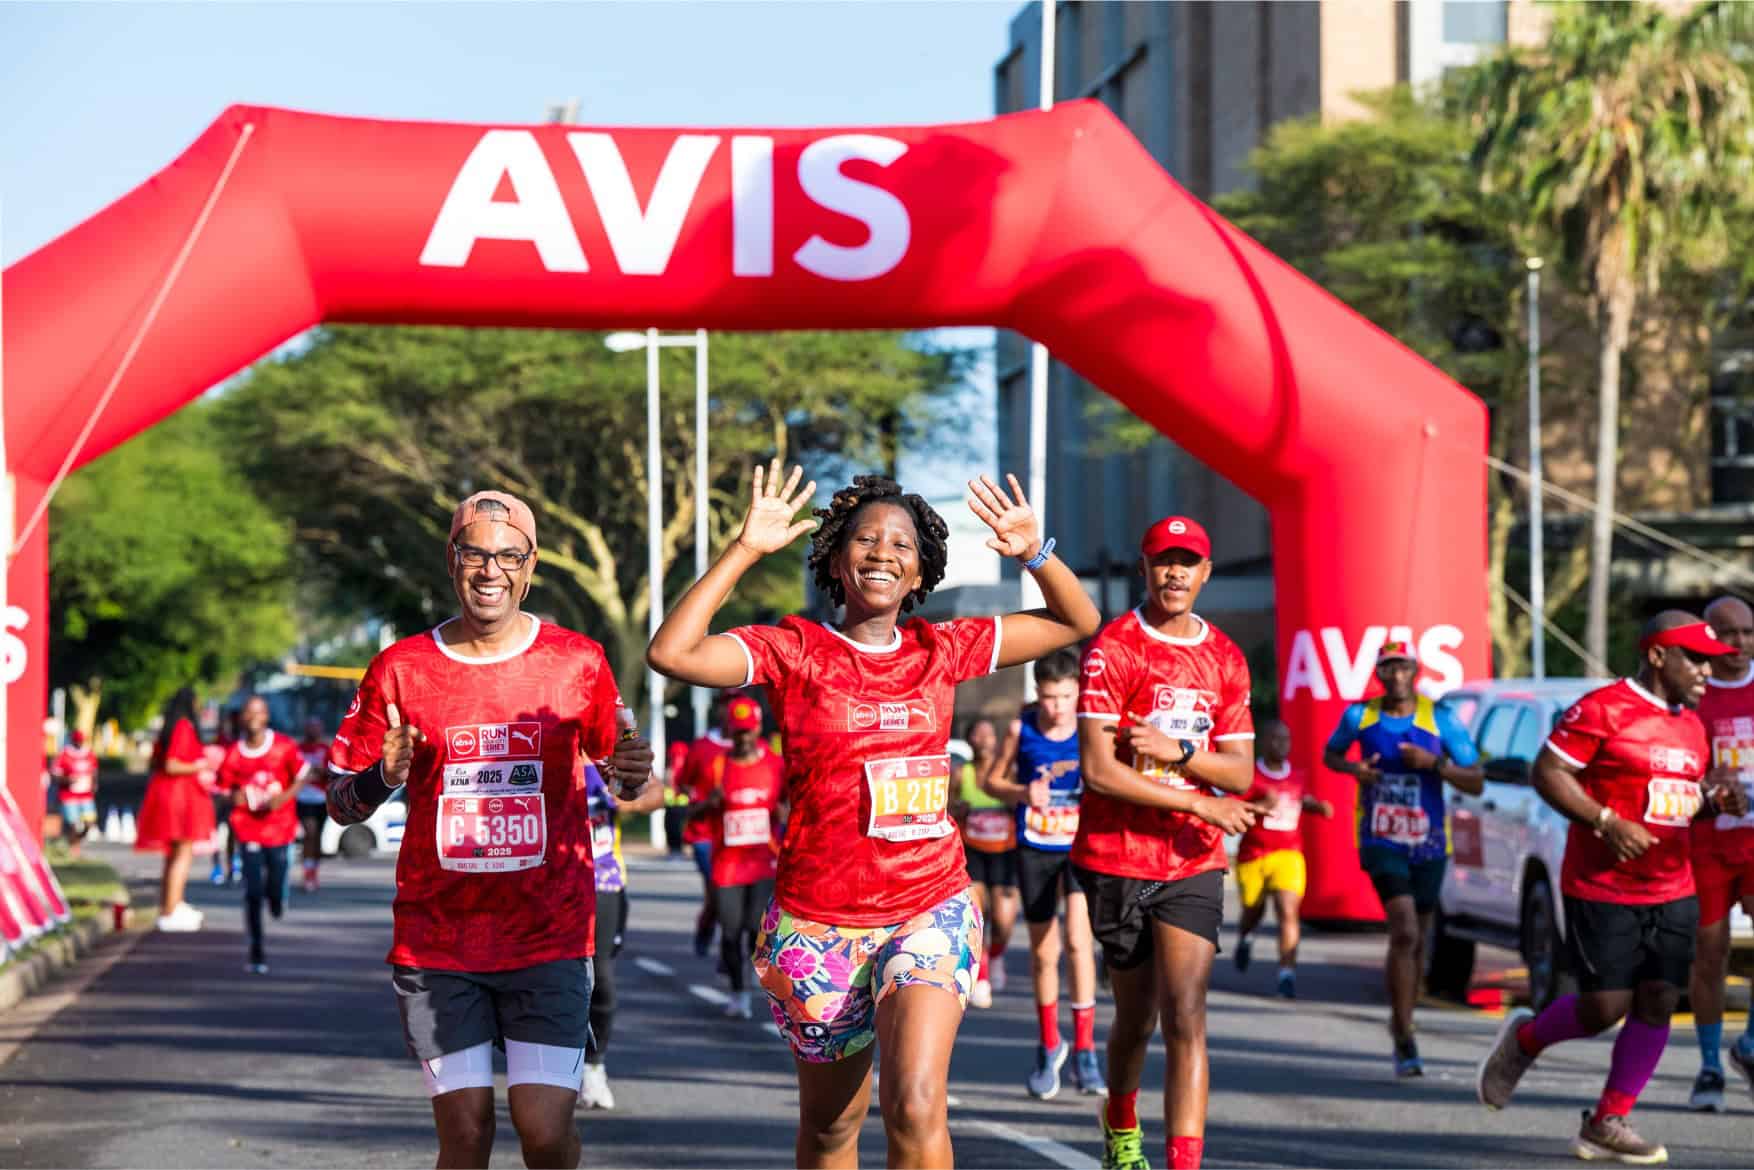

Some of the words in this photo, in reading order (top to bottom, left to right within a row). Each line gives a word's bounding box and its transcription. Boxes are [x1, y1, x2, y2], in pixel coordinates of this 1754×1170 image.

[419, 129, 911, 281] AVIS
[481, 728, 506, 739] RUN
[477, 769, 502, 784] 2025
[513, 766, 536, 777] ASA
[884, 783, 897, 813] B
[907, 778, 945, 813] 215
[450, 815, 464, 846] C
[475, 814, 538, 846] 5350
[487, 847, 512, 856] 2025
